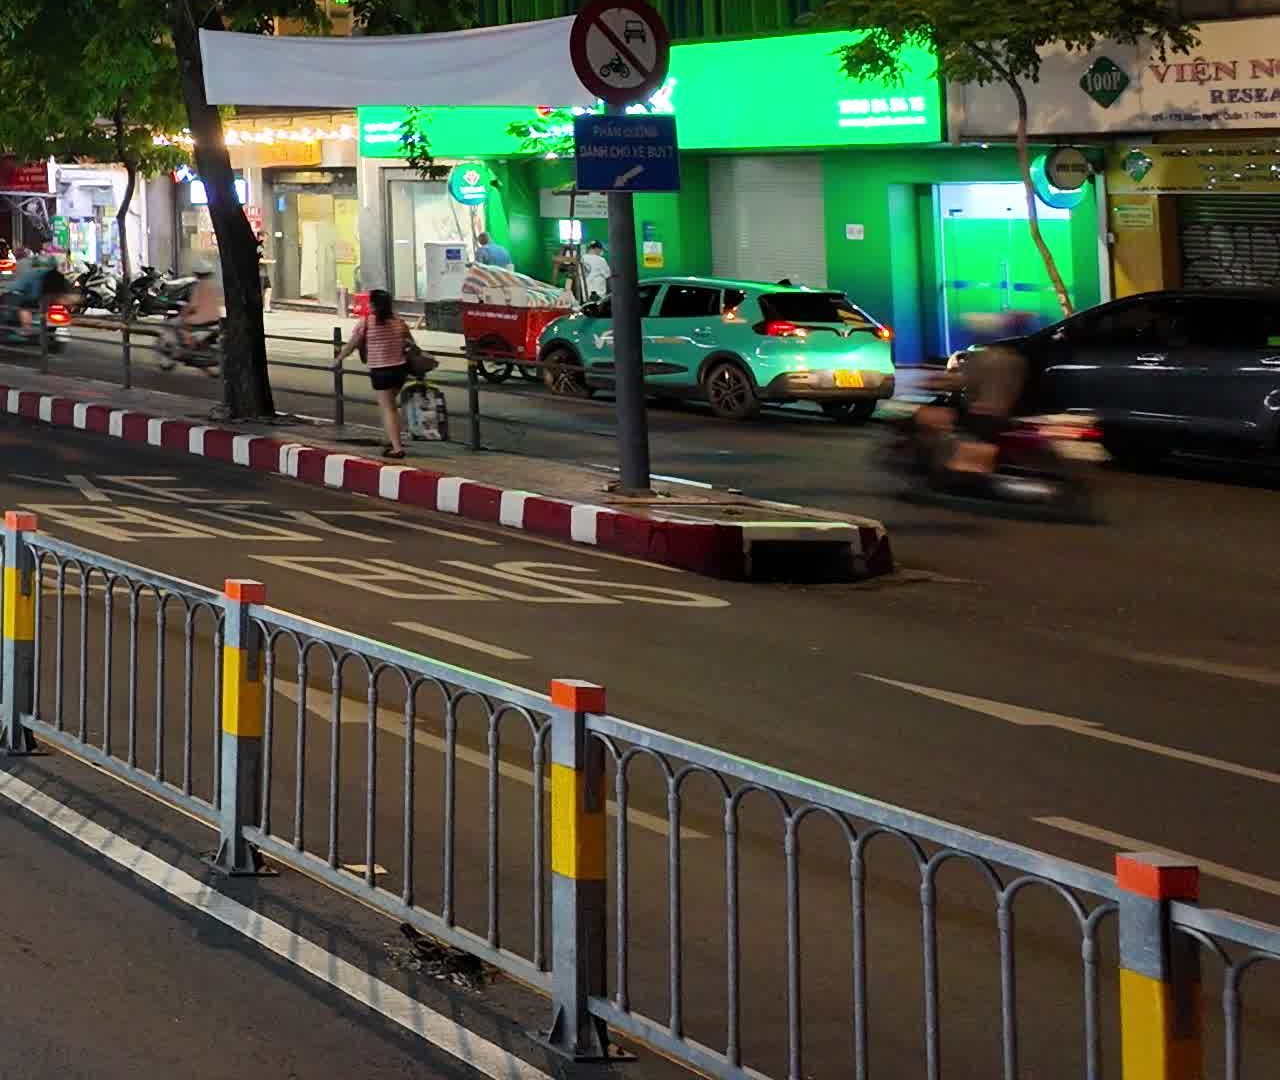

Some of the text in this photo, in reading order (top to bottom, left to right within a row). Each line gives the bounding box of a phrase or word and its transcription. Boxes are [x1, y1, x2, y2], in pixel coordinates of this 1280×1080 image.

[1149, 56, 1280, 86] VIỆN N
[246, 553, 733, 608] BUS
